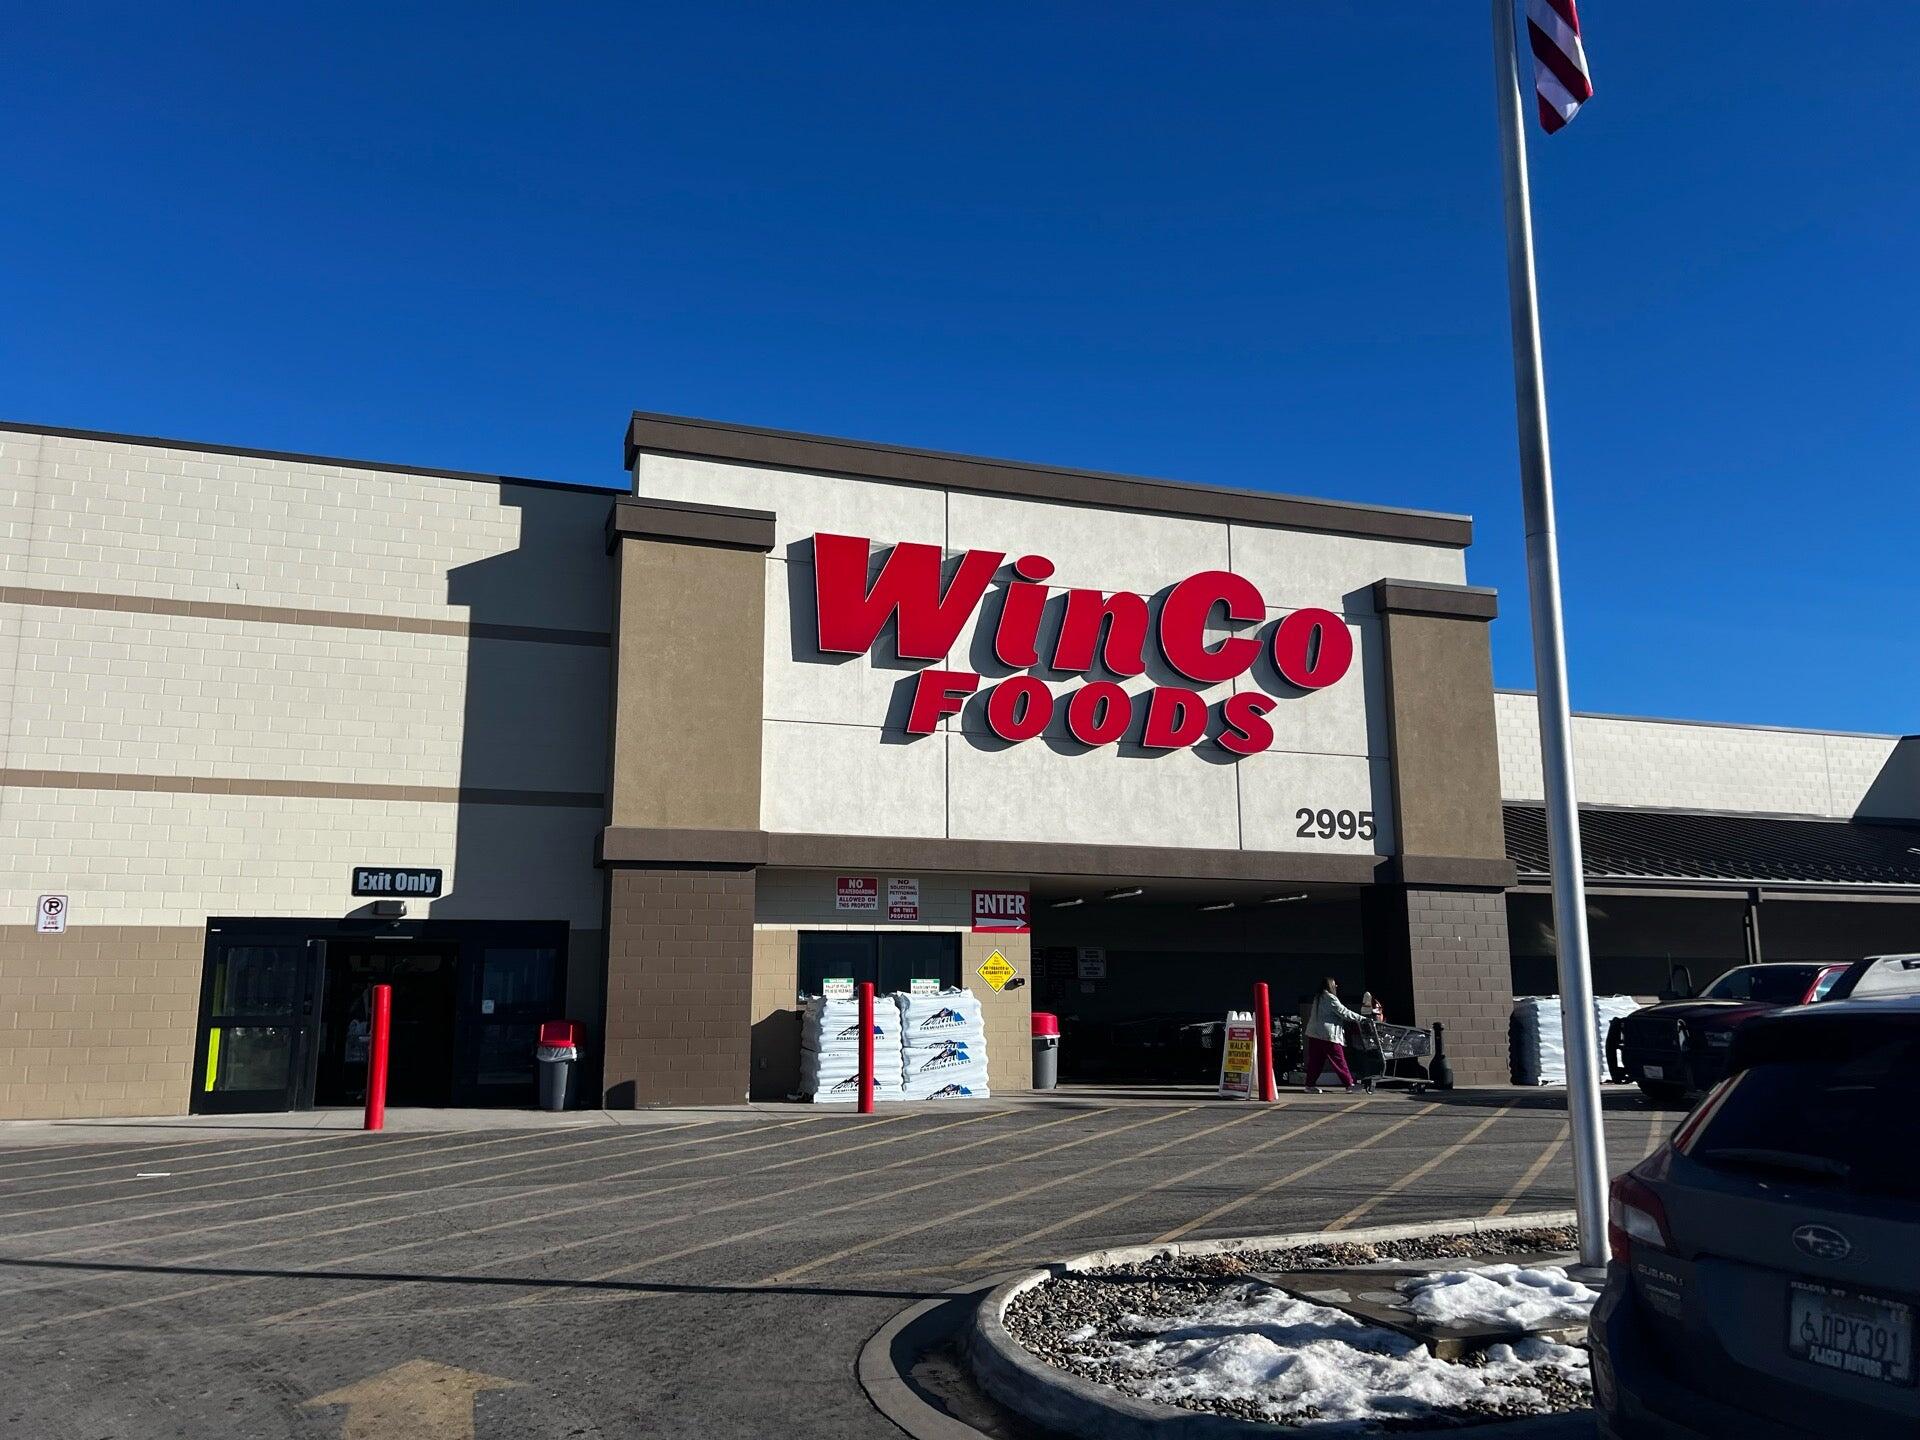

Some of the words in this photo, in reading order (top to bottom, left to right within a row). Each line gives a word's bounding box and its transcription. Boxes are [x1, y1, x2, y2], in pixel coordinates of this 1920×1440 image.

[813, 532, 1353, 689] WinCo
[906, 670, 1278, 755] FOODS
[1296, 808, 1377, 841] 2995
[358, 871, 392, 890] Exit
[395, 872, 437, 893] Only
[849, 879, 863, 889] NO
[975, 893, 1026, 914] ENTER
[945, 1020, 967, 1028] PELLETS
[920, 1063, 946, 1073] PREMIUM
[947, 1059, 971, 1068] PELLETS
